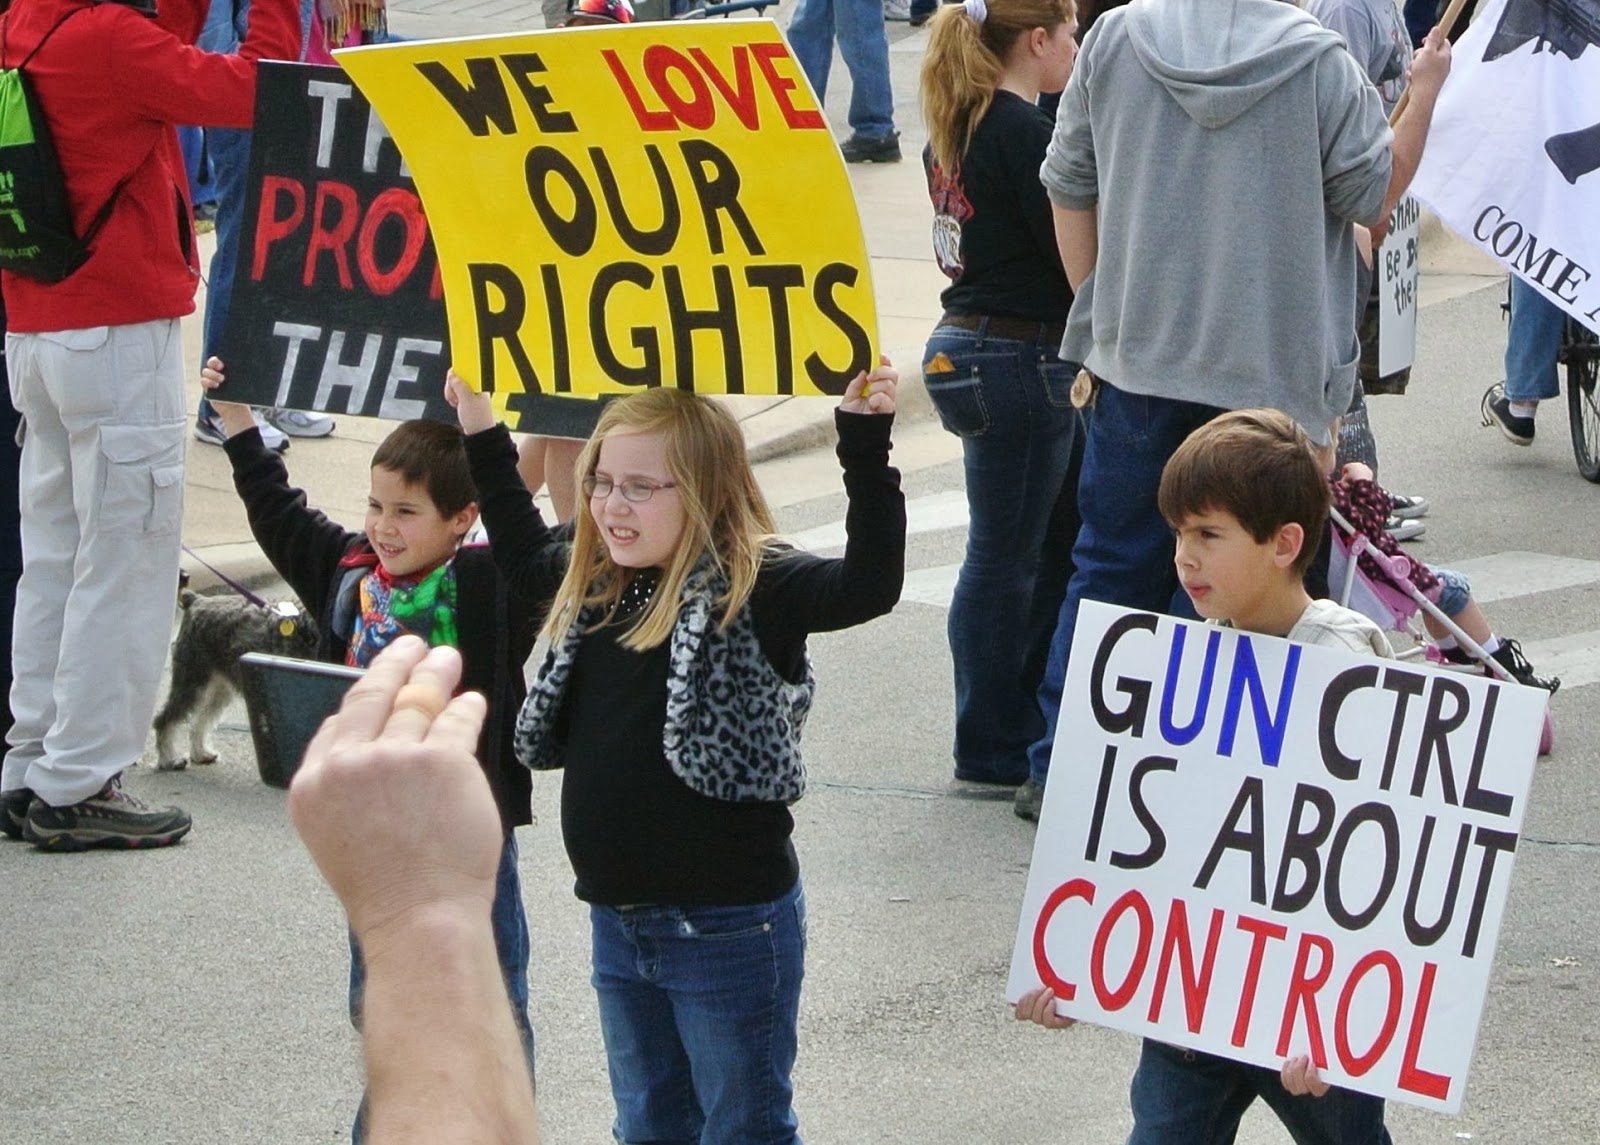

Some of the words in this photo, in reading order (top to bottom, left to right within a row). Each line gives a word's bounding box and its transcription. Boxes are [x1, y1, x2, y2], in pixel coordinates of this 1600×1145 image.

[413, 52, 578, 136] WE
[602, 43, 827, 132] LOVE
[251, 175, 443, 300] PRO
[525, 140, 766, 257] OUR
[1473, 205, 1591, 305] COME
[273, 321, 442, 418] THE
[468, 261, 873, 396] RIGHTS
[1090, 613, 1302, 767] GUN
[1318, 665, 1514, 817] CTRL
[1084, 744, 1178, 869] IS
[1192, 776, 1519, 958] ABOUT
[1033, 878, 1451, 1100] CONTROL
